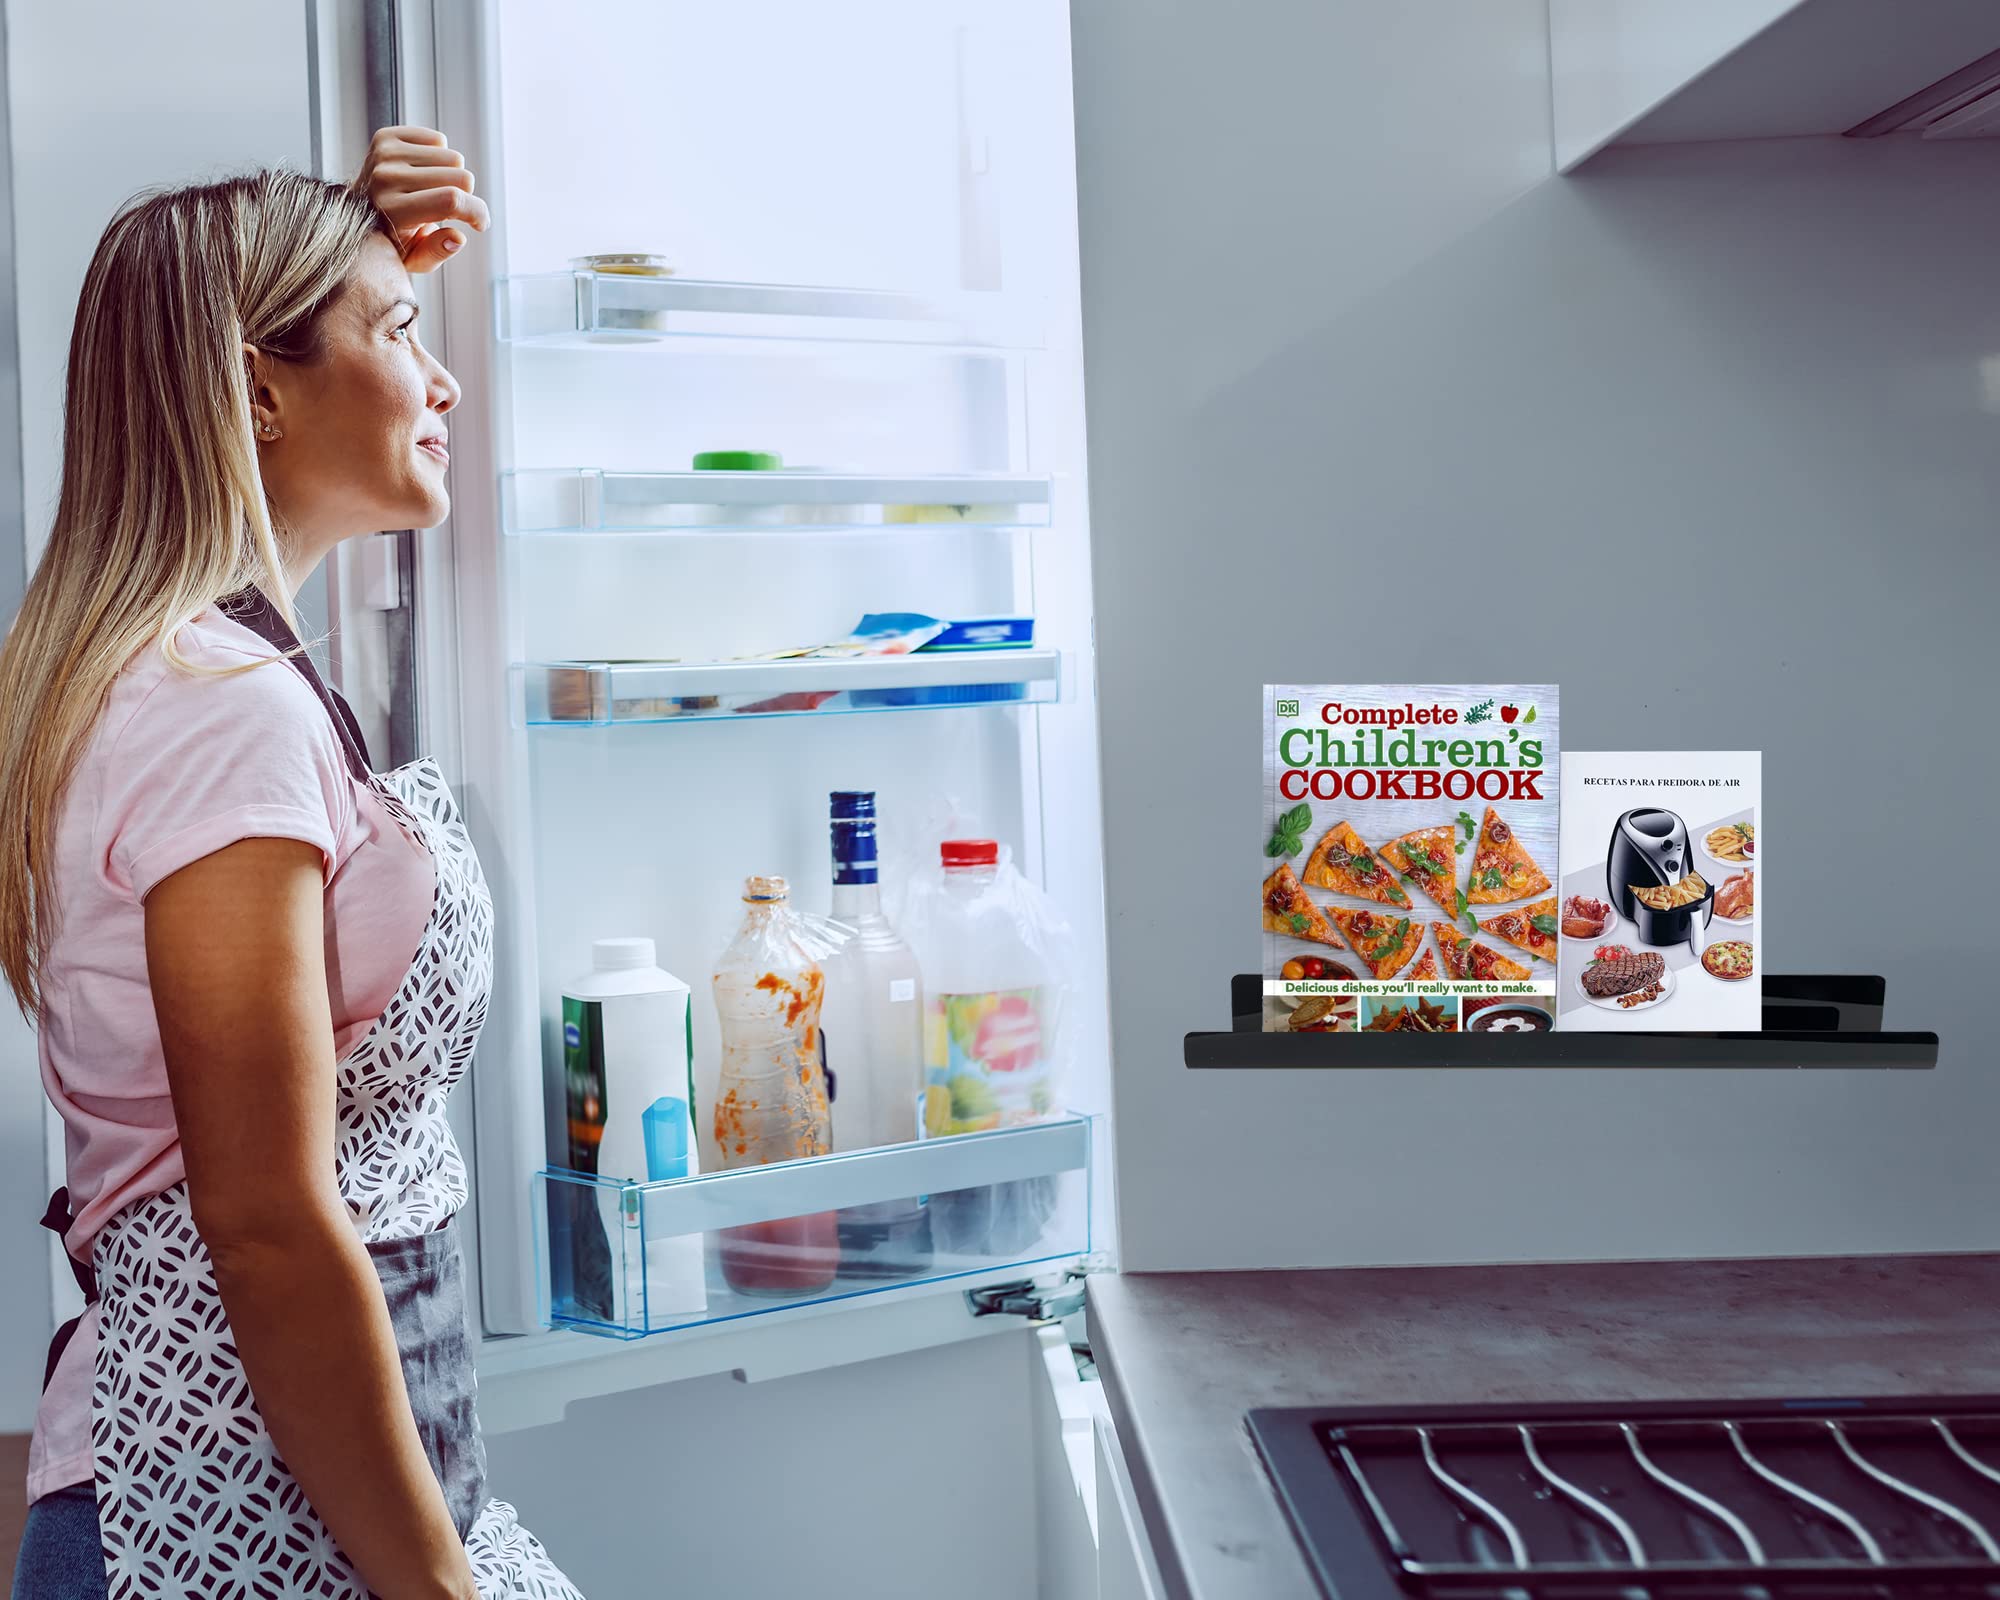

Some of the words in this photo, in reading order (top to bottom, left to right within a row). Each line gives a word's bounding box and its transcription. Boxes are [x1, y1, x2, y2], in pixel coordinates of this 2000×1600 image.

[1279, 703, 1297, 714] DK
[1321, 703, 1458, 729] Complete
[1279, 728, 1544, 767] Children's
[1279, 769, 1544, 800] COOKBOOK
[1583, 777, 1628, 786] RECETAS
[1629, 778, 1655, 787] PARA
[1657, 778, 1706, 787] FREIDORA
[1708, 778, 1722, 787] DE
[1723, 778, 1741, 787] AIR
[1285, 982, 1339, 994] Delicious
[1342, 982, 1379, 994] dishes
[1381, 982, 1415, 996] you'll
[1417, 982, 1450, 996] really
[1452, 984, 1483, 994] want
[1485, 984, 1499, 994] to
[1501, 982, 1537, 994] make.
